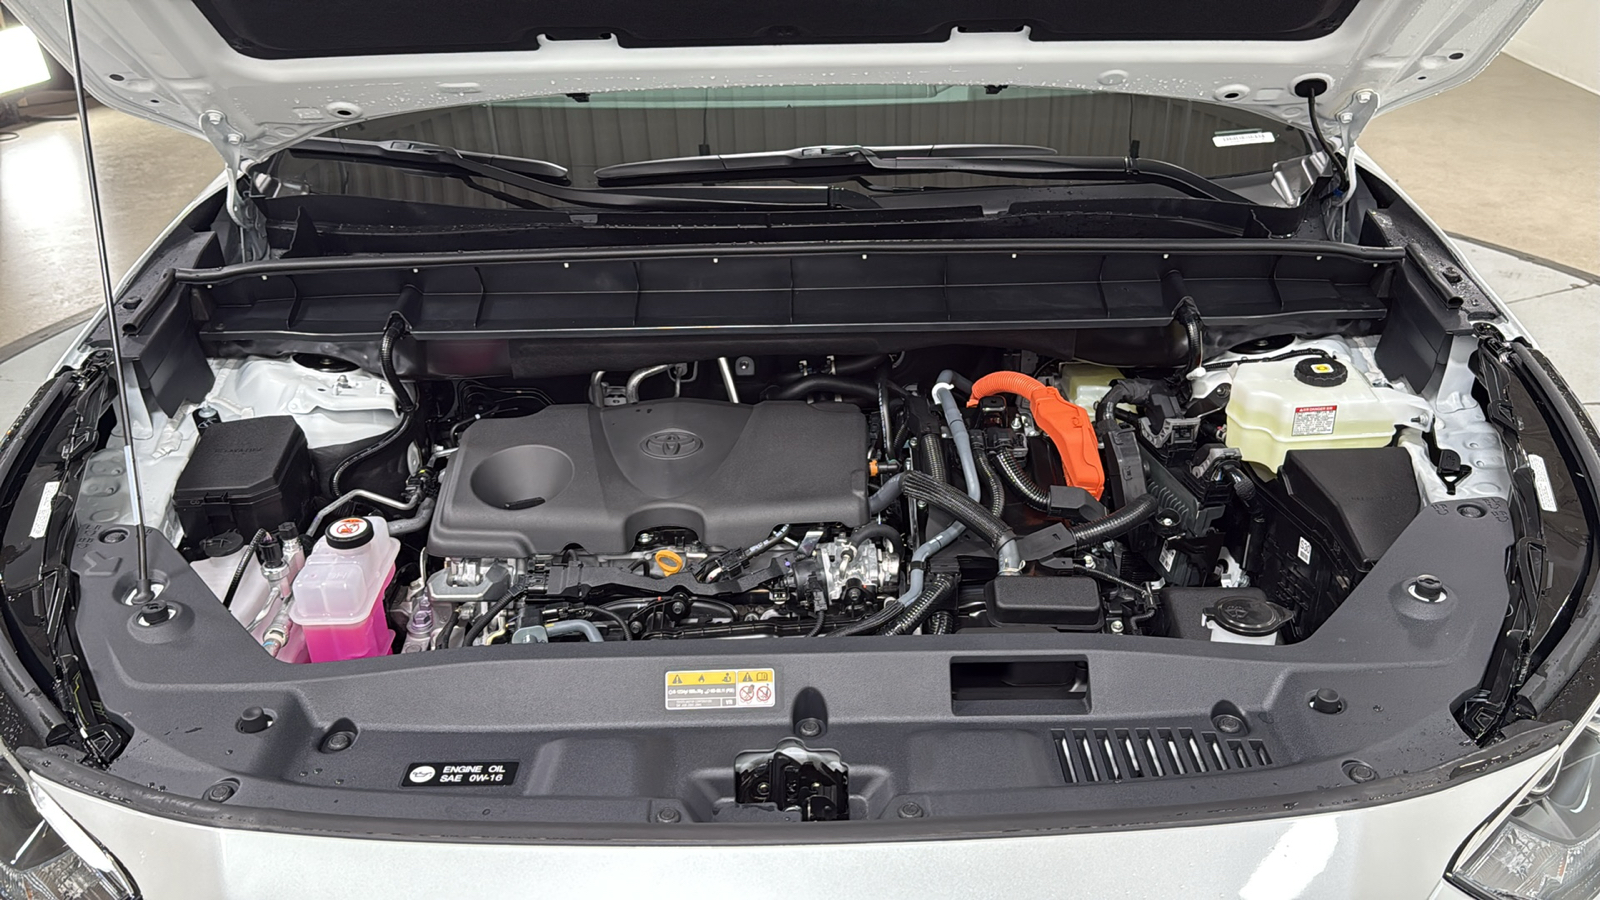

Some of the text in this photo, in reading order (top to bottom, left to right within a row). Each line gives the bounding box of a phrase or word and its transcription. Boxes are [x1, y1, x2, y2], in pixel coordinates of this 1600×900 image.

[442, 765, 506, 774] ENGINE OIL
[439, 774, 504, 783] SAE 0W-16
